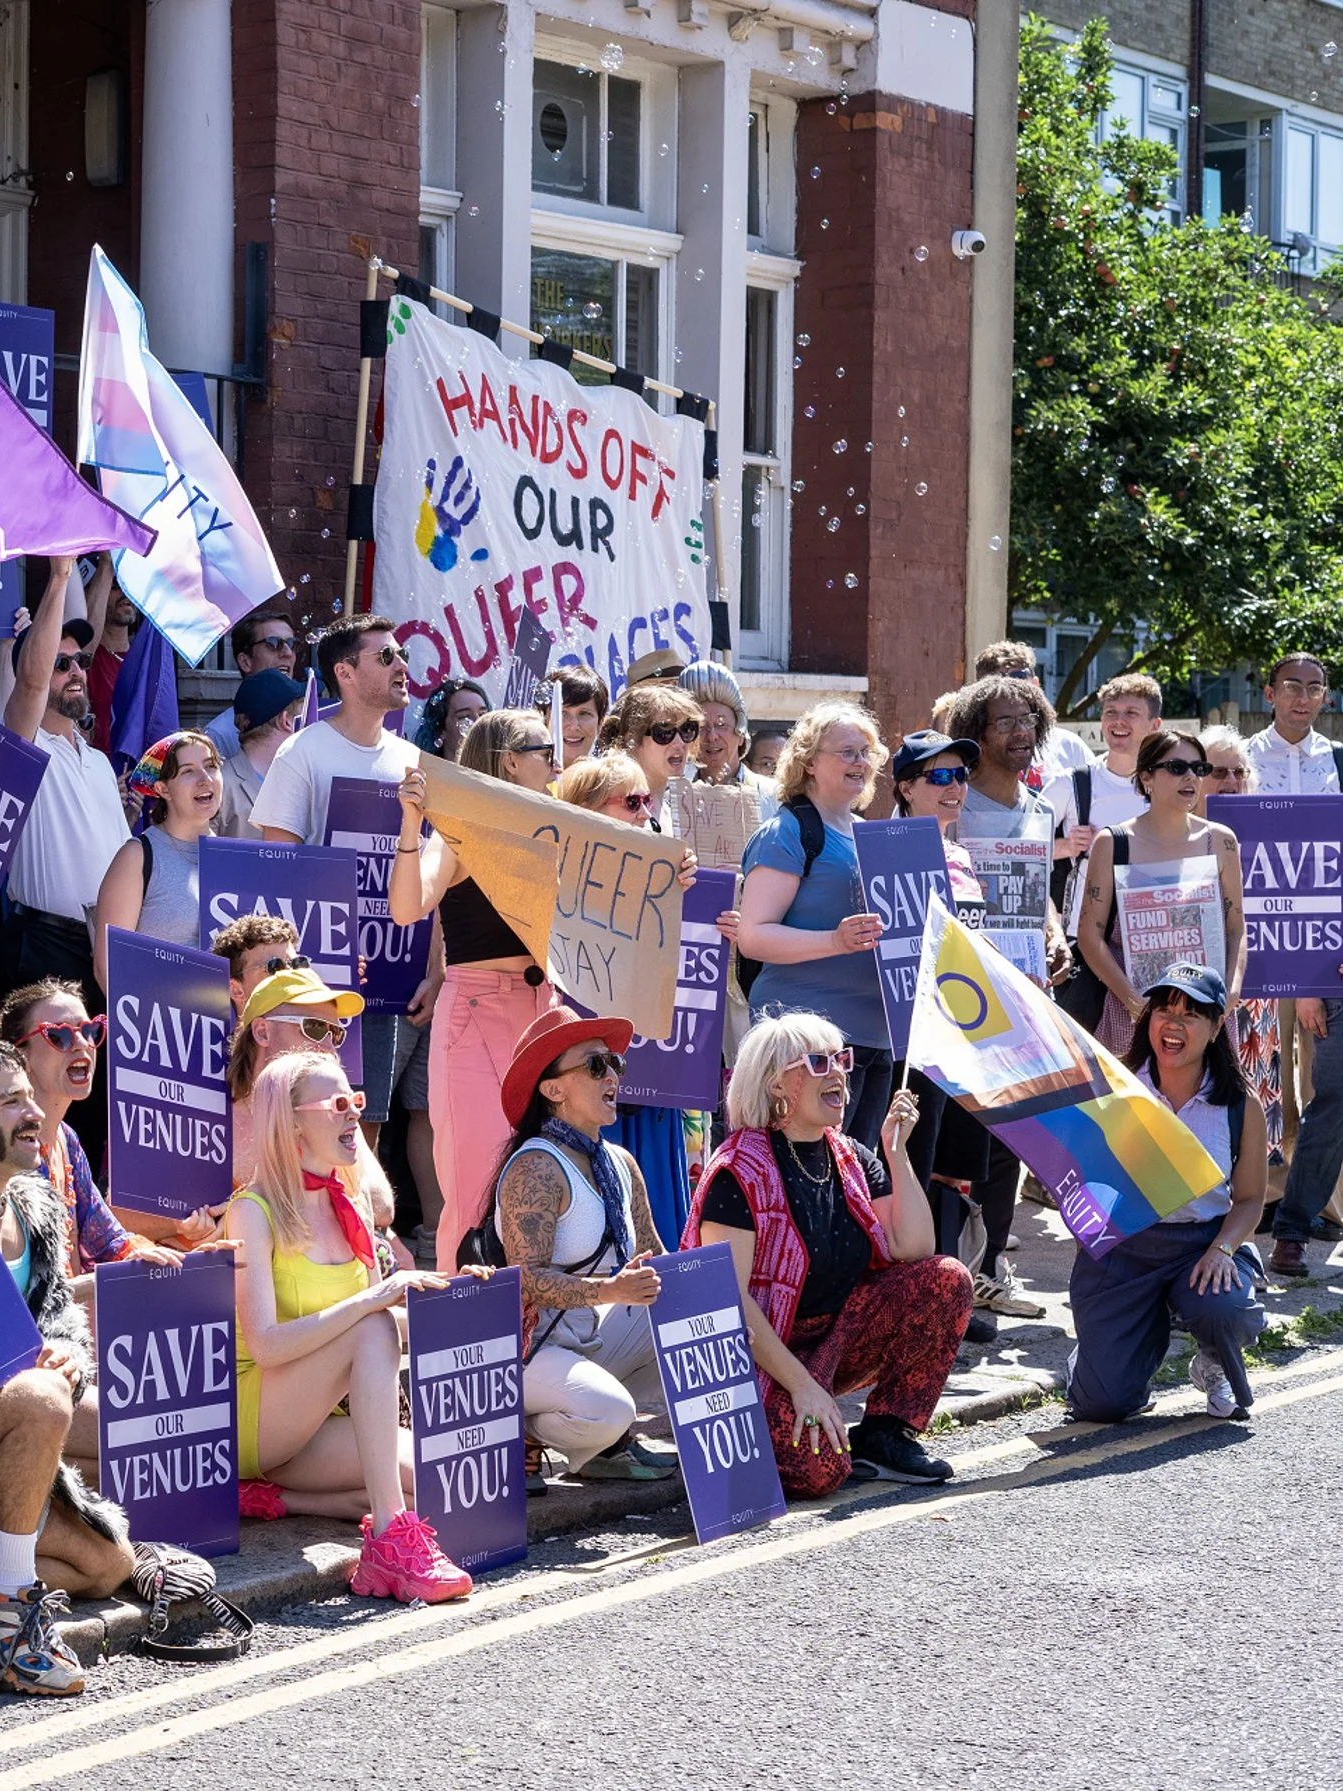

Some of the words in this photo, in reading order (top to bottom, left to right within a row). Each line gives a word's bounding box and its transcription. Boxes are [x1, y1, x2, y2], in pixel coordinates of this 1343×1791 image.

[534, 278, 564, 309] THE
[437, 371, 587, 480] HANDS
[601, 429, 675, 521] OFF
[514, 474, 616, 563] OUR
[393, 560, 598, 701] QUEER
[1260, 801, 1294, 809] EQUITY
[886, 825, 909, 836] EQUITY
[371, 834, 395, 853] YOU
[994, 842, 1047, 857] Socialist
[259, 848, 298, 860] EQUITY
[983, 861, 1002, 873] time
[1002, 862, 1010, 873] to
[1242, 842, 1341, 889] AVE
[998, 876, 1025, 895] PAY
[1153, 883, 1215, 903] Socialist
[1002, 895, 1022, 914] UP
[1263, 898, 1293, 912] OUR
[1128, 910, 1167, 929] FUND
[358, 918, 415, 963] OU!
[1130, 929, 1200, 951] SERVICES
[1246, 920, 1341, 952] ENUES
[154, 947, 185, 964] EQUITY
[1175, 950, 1205, 966] NOT
[1262, 984, 1297, 992] EQUITY
[116, 994, 226, 1080] SAVE
[158, 1081, 185, 1103] OUR
[618, 1085, 658, 1097] EQUITY
[116, 1100, 227, 1165] VENUES
[158, 1195, 187, 1211] EQUITY
[1055, 1168, 1116, 1249] EQUITY
[149, 1265, 182, 1280] EQUITY
[677, 1259, 702, 1273] EQUITY
[452, 1285, 481, 1300] EQUITY
[687, 1315, 716, 1337] YOUR
[107, 1320, 229, 1409] SAVE
[453, 1349, 485, 1369] YOUR
[663, 1332, 751, 1394] VENUES
[418, 1363, 519, 1428] VENUES
[706, 1394, 732, 1415] NEED
[155, 1412, 184, 1437] OUR
[457, 1426, 486, 1451] NEED
[693, 1411, 760, 1474] YOU!
[110, 1439, 232, 1503] VENUES
[436, 1446, 509, 1514] YOU!
[731, 1509, 755, 1526] EQUITY
[461, 1551, 489, 1568] EQUITY
